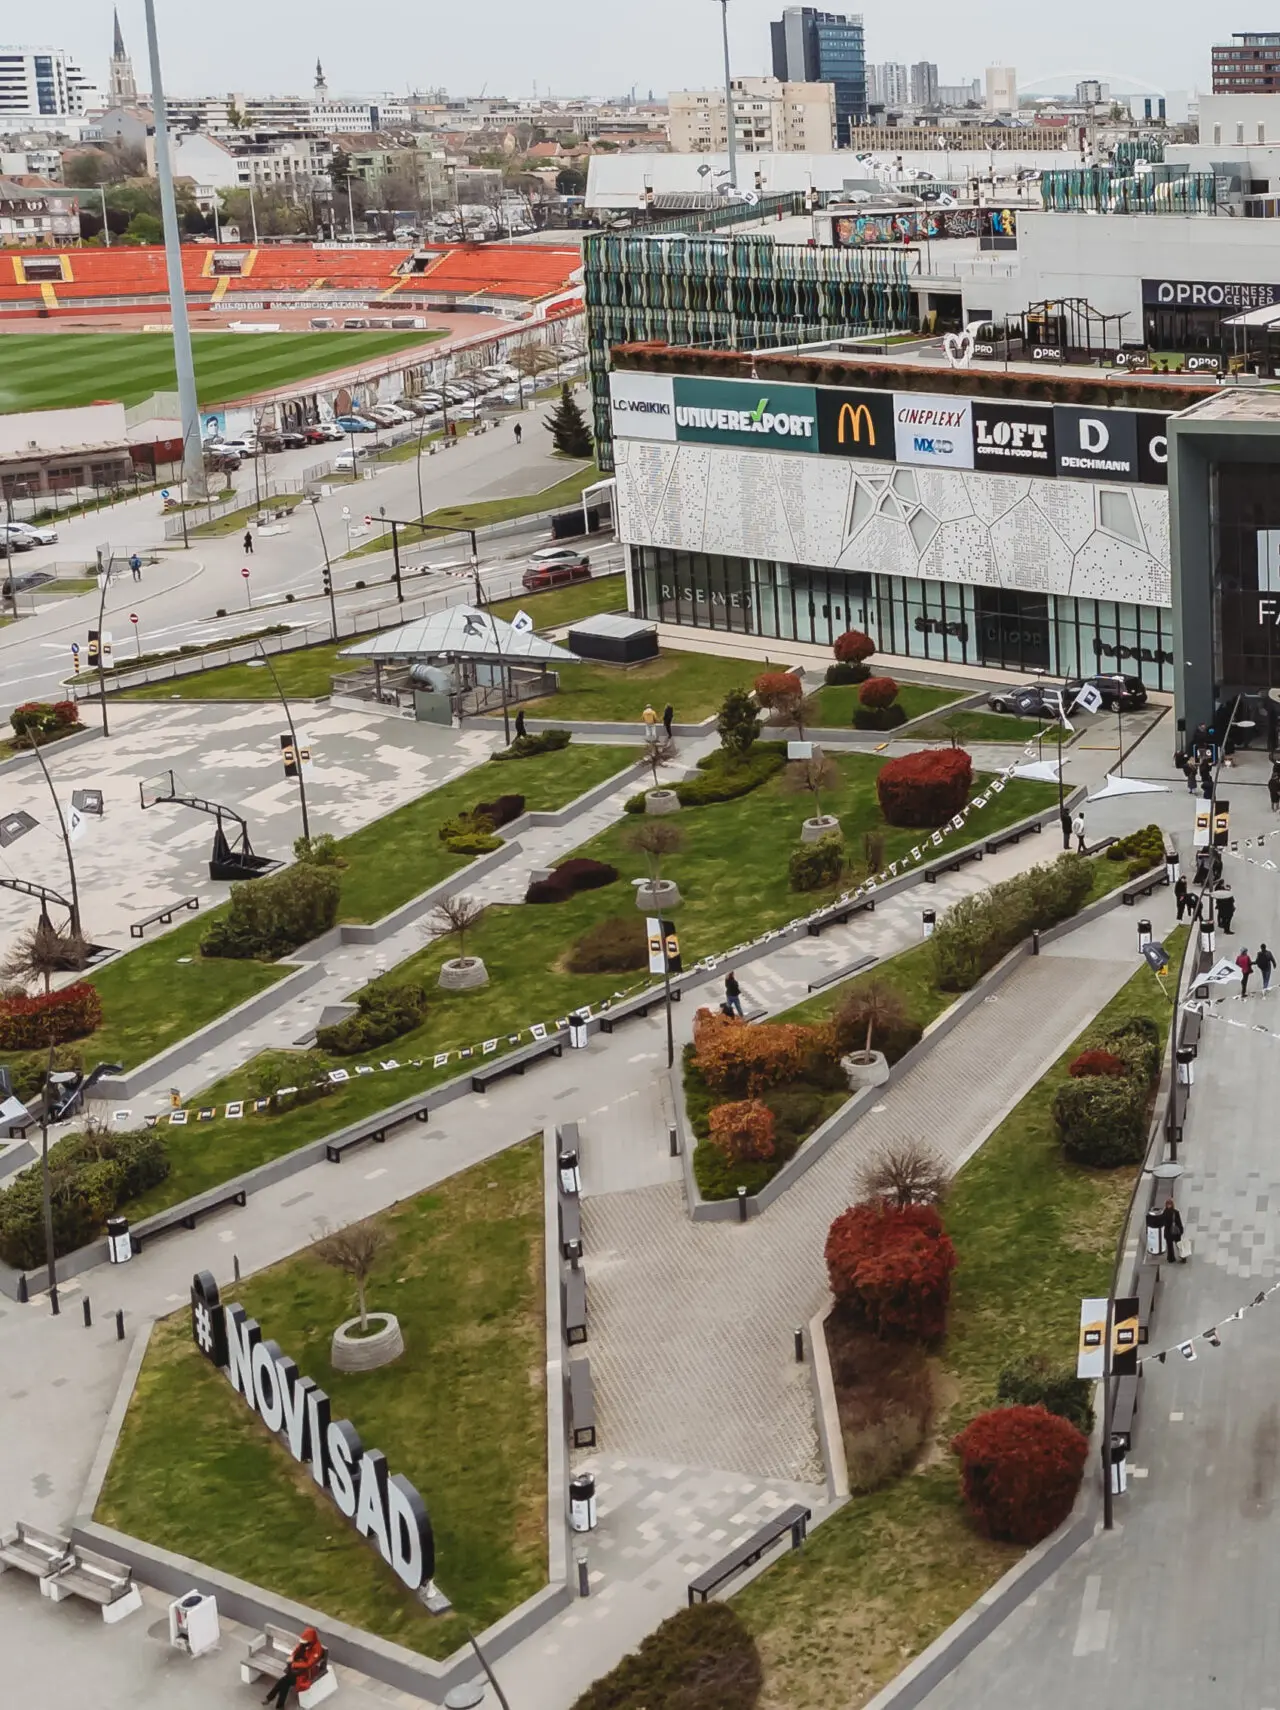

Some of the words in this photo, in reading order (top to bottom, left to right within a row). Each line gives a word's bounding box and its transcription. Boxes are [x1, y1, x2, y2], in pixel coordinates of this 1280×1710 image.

[1224, 284, 1274, 297] FITNESS
[1224, 295, 1274, 306] CENTER
[613, 399, 628, 411] LC
[676, 399, 815, 437] UNIVEREXPORT
[897, 408, 966, 428] CINEPLEXX
[975, 420, 1047, 449] LOFT
[977, 446, 1004, 456] COFFEE
[1004, 447, 1011, 456] &
[1011, 448, 1033, 458] FOOD
[1033, 449, 1048, 460] BAR
[1061, 456, 1131, 472] DEICHMANN
[661, 584, 752, 609] RSERVE
